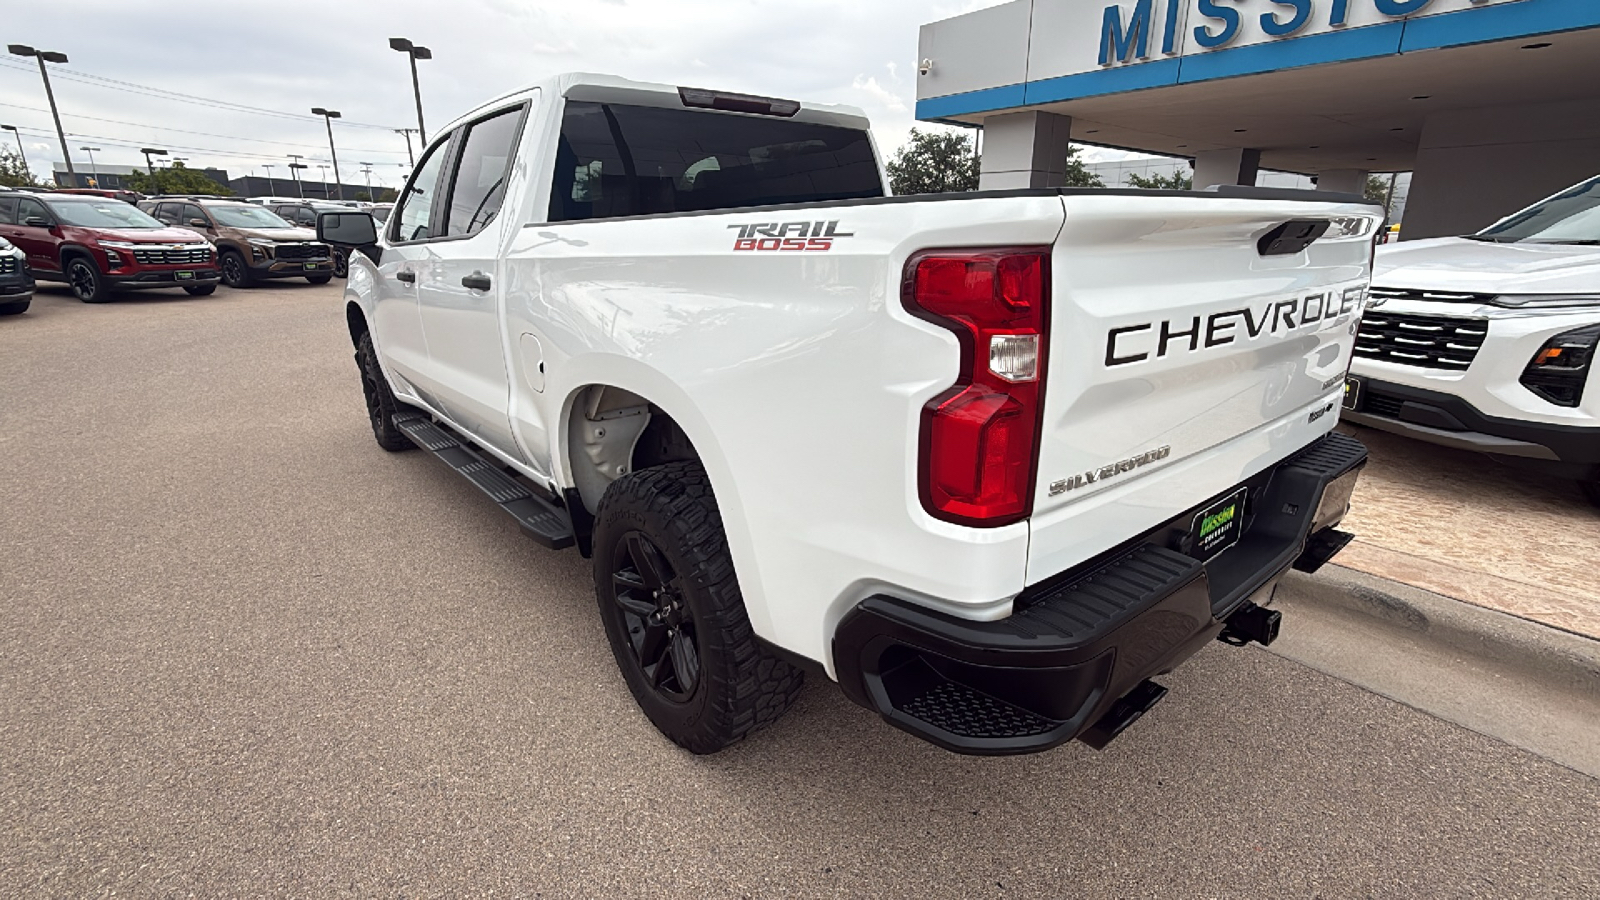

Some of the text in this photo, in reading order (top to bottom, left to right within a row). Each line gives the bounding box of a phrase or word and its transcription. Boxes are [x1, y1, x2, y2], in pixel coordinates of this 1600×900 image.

[727, 220, 854, 238] TRAIL
[733, 238, 834, 251] BOSS
[1104, 282, 1368, 366] CHEVROLET
[1048, 444, 1171, 497] SILVERADO
